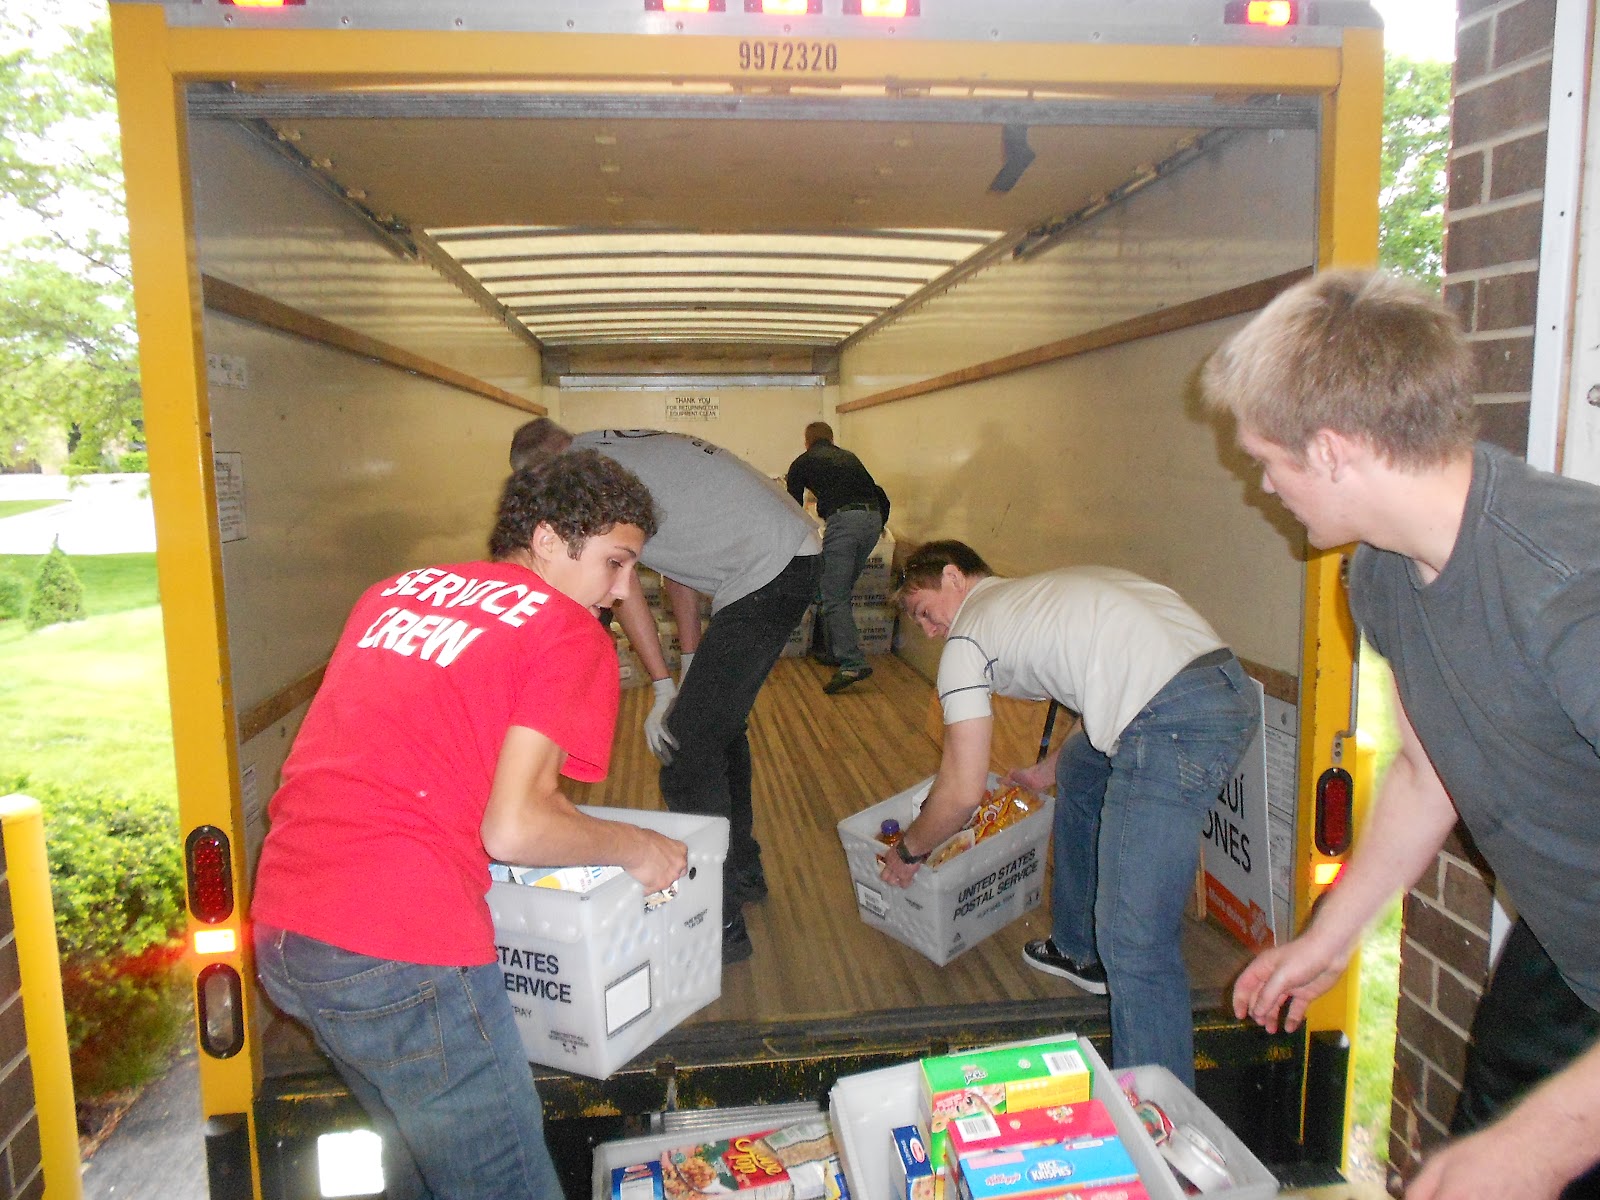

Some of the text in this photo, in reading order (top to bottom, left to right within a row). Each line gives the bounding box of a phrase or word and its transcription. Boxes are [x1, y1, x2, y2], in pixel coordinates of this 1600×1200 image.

[739, 41, 838, 71] 9972320
[381, 567, 550, 628] SERVICE
[357, 606, 484, 668] CREW
[953, 888, 995, 921] POSTAL
[997, 860, 1039, 895] SERVICE
[958, 872, 997, 903] UNITED
[998, 848, 1036, 880] STATES
[496, 945, 560, 975] TATES
[1030, 1165, 1073, 1181] KRISPIES
[1037, 1160, 1058, 1172] RICE
